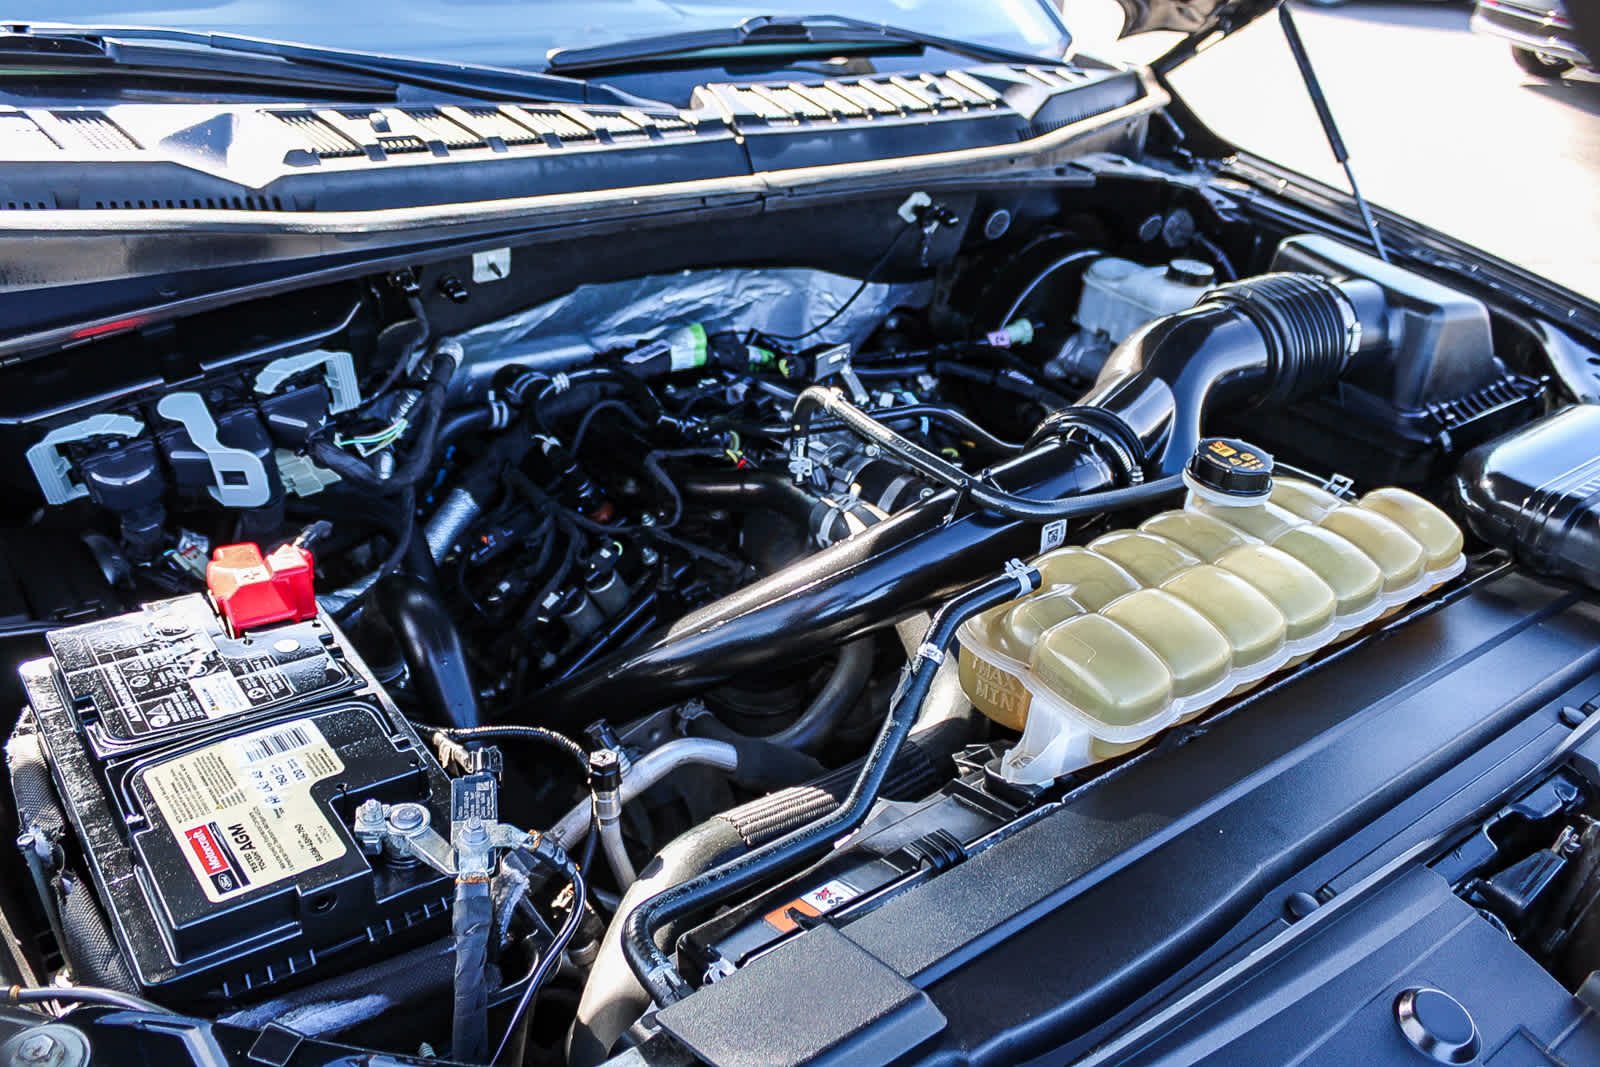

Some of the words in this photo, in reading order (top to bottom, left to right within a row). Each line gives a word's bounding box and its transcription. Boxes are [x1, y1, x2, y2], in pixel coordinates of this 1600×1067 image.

[976, 679, 1014, 712] MIN
[193, 829, 221, 870] Motorcraft
[228, 823, 256, 850] AGM
[243, 852, 259, 873] TESTED
